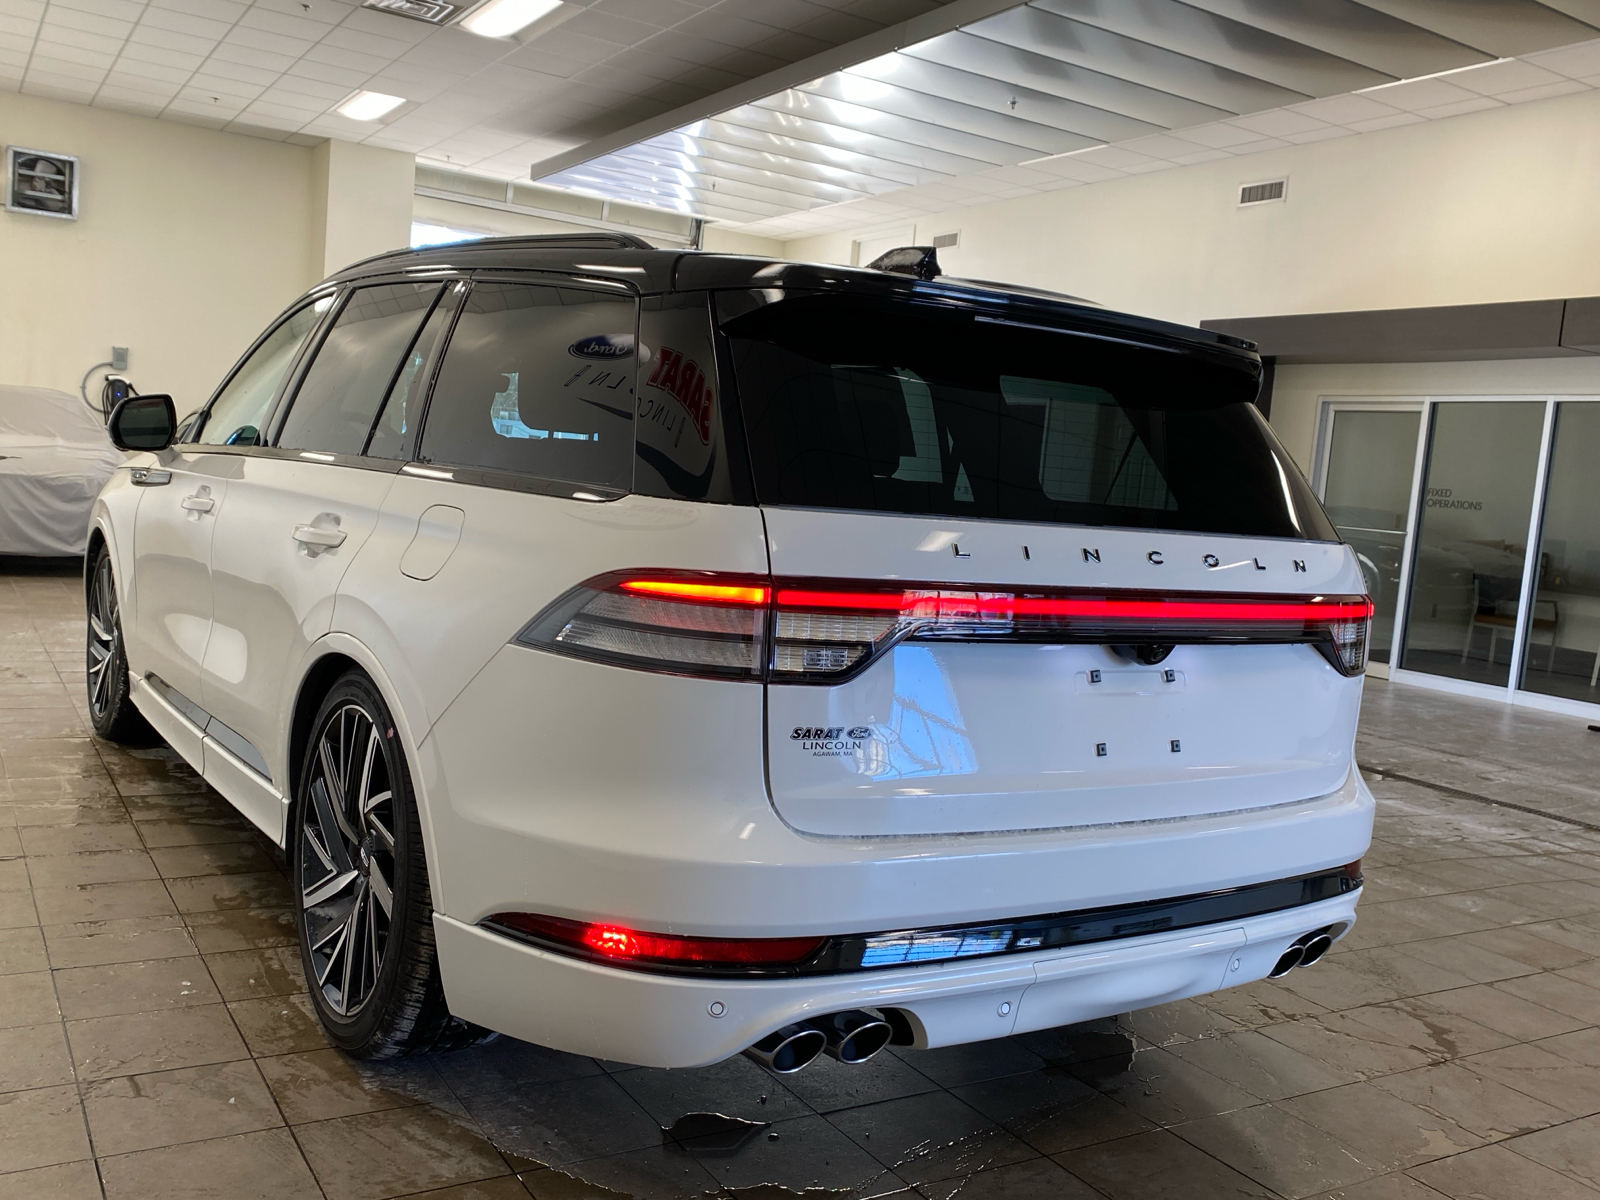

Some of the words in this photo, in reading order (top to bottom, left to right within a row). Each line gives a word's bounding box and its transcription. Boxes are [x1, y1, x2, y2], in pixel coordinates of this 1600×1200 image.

[1427, 488, 1452, 498] FIXED
[1426, 498, 1483, 511] OPERATIONS
[952, 543, 1307, 573] LINCOLN
[790, 727, 844, 740] SARAT
[851, 728, 870, 738] Ford
[802, 741, 861, 750] LINCOLN
